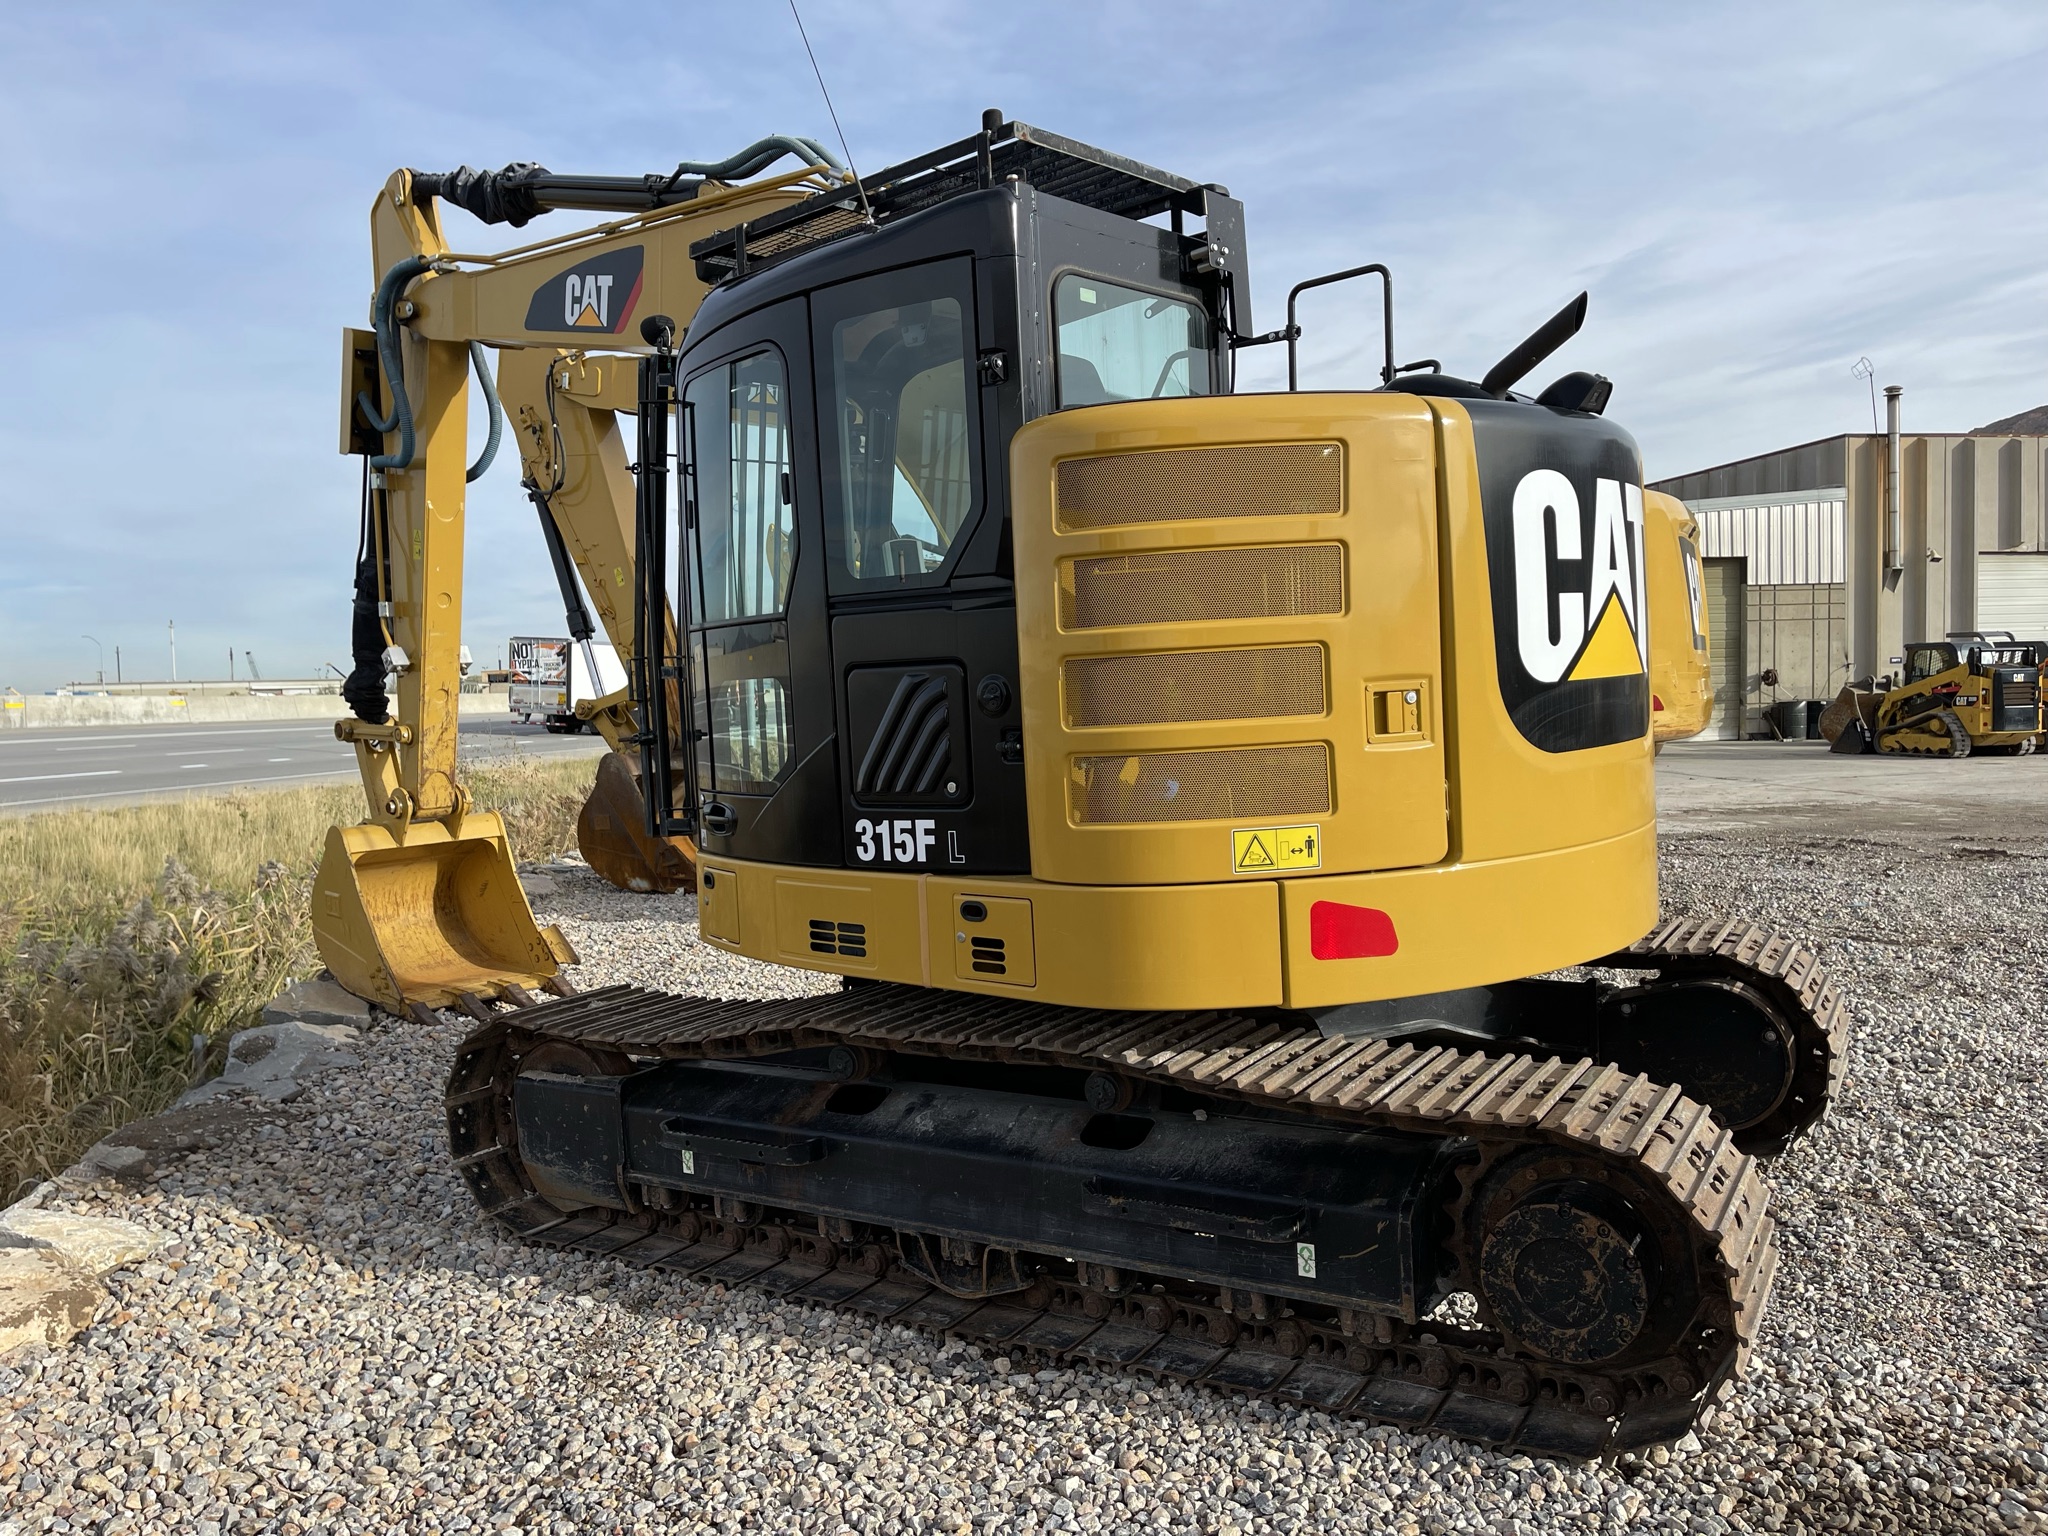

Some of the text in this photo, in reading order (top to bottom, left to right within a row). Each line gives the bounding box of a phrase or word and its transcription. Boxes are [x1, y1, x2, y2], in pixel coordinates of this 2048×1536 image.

[564, 273, 613, 328] CAT
[1512, 468, 1648, 683] CAT
[2013, 673, 2025, 682] CAT
[1956, 696, 1968, 706] CAT
[855, 818, 966, 864] 315F L
